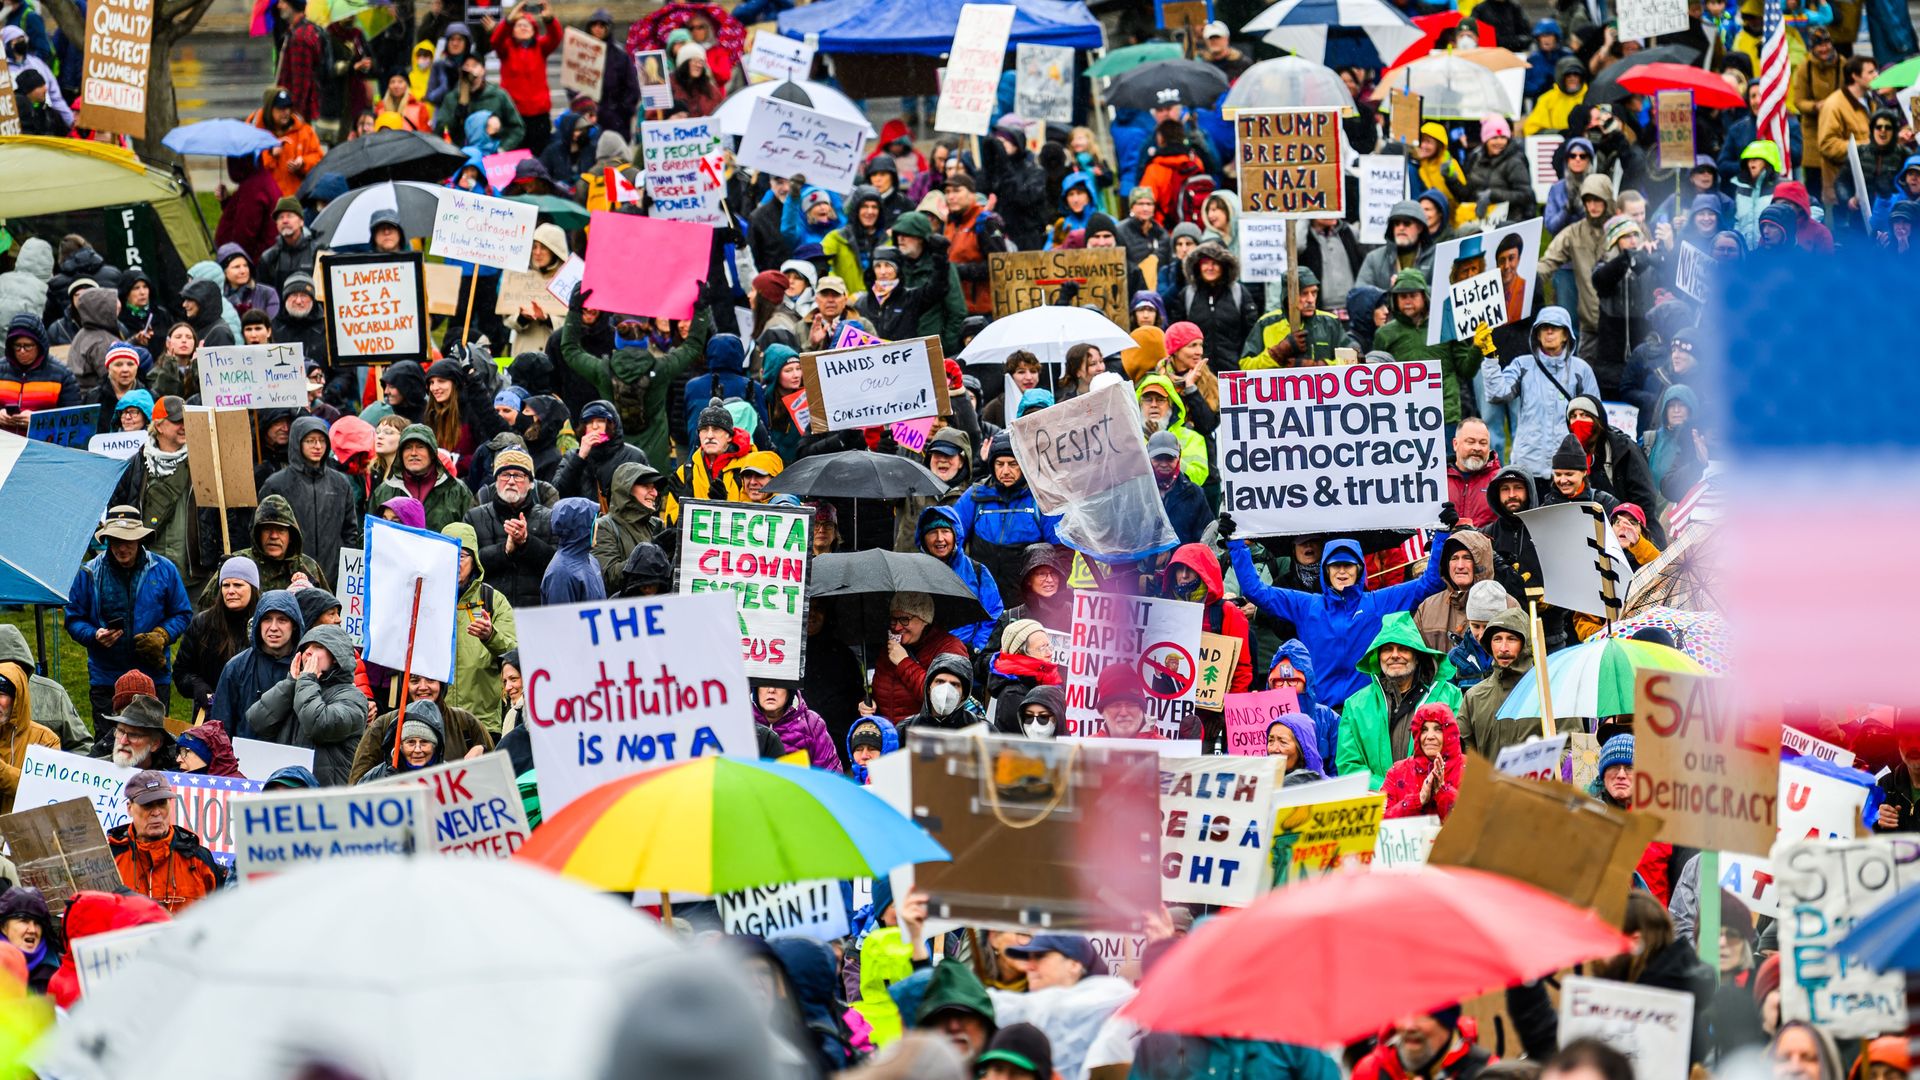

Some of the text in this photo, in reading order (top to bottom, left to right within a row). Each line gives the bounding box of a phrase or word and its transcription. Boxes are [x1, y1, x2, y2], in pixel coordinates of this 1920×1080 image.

[93, 5, 150, 38] QUALITY
[90, 34, 149, 64] RESPECT
[88, 59, 146, 88] WOMENS
[648, 125, 711, 142] The POWER
[1239, 113, 1328, 138] TRUMP
[645, 143, 713, 160] OF PEOPLE
[1243, 144, 1326, 163] BREEDS
[648, 164, 657, 172] IS
[648, 172, 697, 185] THAN THE
[1263, 168, 1318, 190] NAZI
[1371, 170, 1401, 181] MAKE
[654, 184, 697, 197] PEOPLE
[1250, 191, 1326, 211] SCUM
[472, 200, 484, 210] the
[490, 208, 514, 220] people
[655, 195, 706, 212] POWER!
[442, 212, 459, 223] are
[450, 231, 471, 246] United
[474, 236, 496, 249] States
[350, 286, 391, 302] IS A
[1453, 279, 1499, 308] Listen
[338, 300, 401, 319] FASCIST
[342, 315, 414, 337] VOCABULARY
[353, 337, 395, 355] WORD
[205, 351, 253, 368] This is
[824, 348, 913, 378] HANDS OFF
[205, 372, 213, 387] A
[219, 369, 258, 385] MORAL
[1218, 362, 1442, 406] Trump GOP=
[215, 393, 252, 407] RIGHT
[36, 412, 91, 431] HANDS
[1220, 402, 1443, 441] TRAITOR to
[102, 440, 140, 451] HANDS
[893, 422, 924, 449] TAND
[1224, 437, 1439, 475] democracy,
[1225, 472, 1439, 512] laws & truth
[690, 508, 806, 553] ELECT A
[698, 548, 803, 583] CLOWN
[1075, 594, 1153, 627] TYRANT
[579, 604, 665, 646] THE
[1072, 622, 1145, 655] RAPIST
[1198, 650, 1221, 663] ND
[528, 661, 728, 729] Constitution
[1226, 706, 1265, 726] HANDS
[616, 732, 676, 763] NOT
[690, 726, 724, 758] A
[1232, 730, 1268, 748] GOVERN
[1811, 740, 1839, 762] Your
[1684, 750, 1727, 776] OUR
[24, 757, 125, 797] DEMOCRACY
[1159, 771, 1259, 803] EALTH
[97, 794, 119, 807] IN
[244, 797, 415, 836] HELL NO!
[436, 797, 517, 842] NEVER
[1311, 804, 1381, 830] SUPPORT
[1198, 814, 1231, 843] IS
[1239, 819, 1261, 849] A
[249, 845, 287, 863] Not
[298, 842, 323, 860] My
[1162, 852, 1240, 888] GHT
